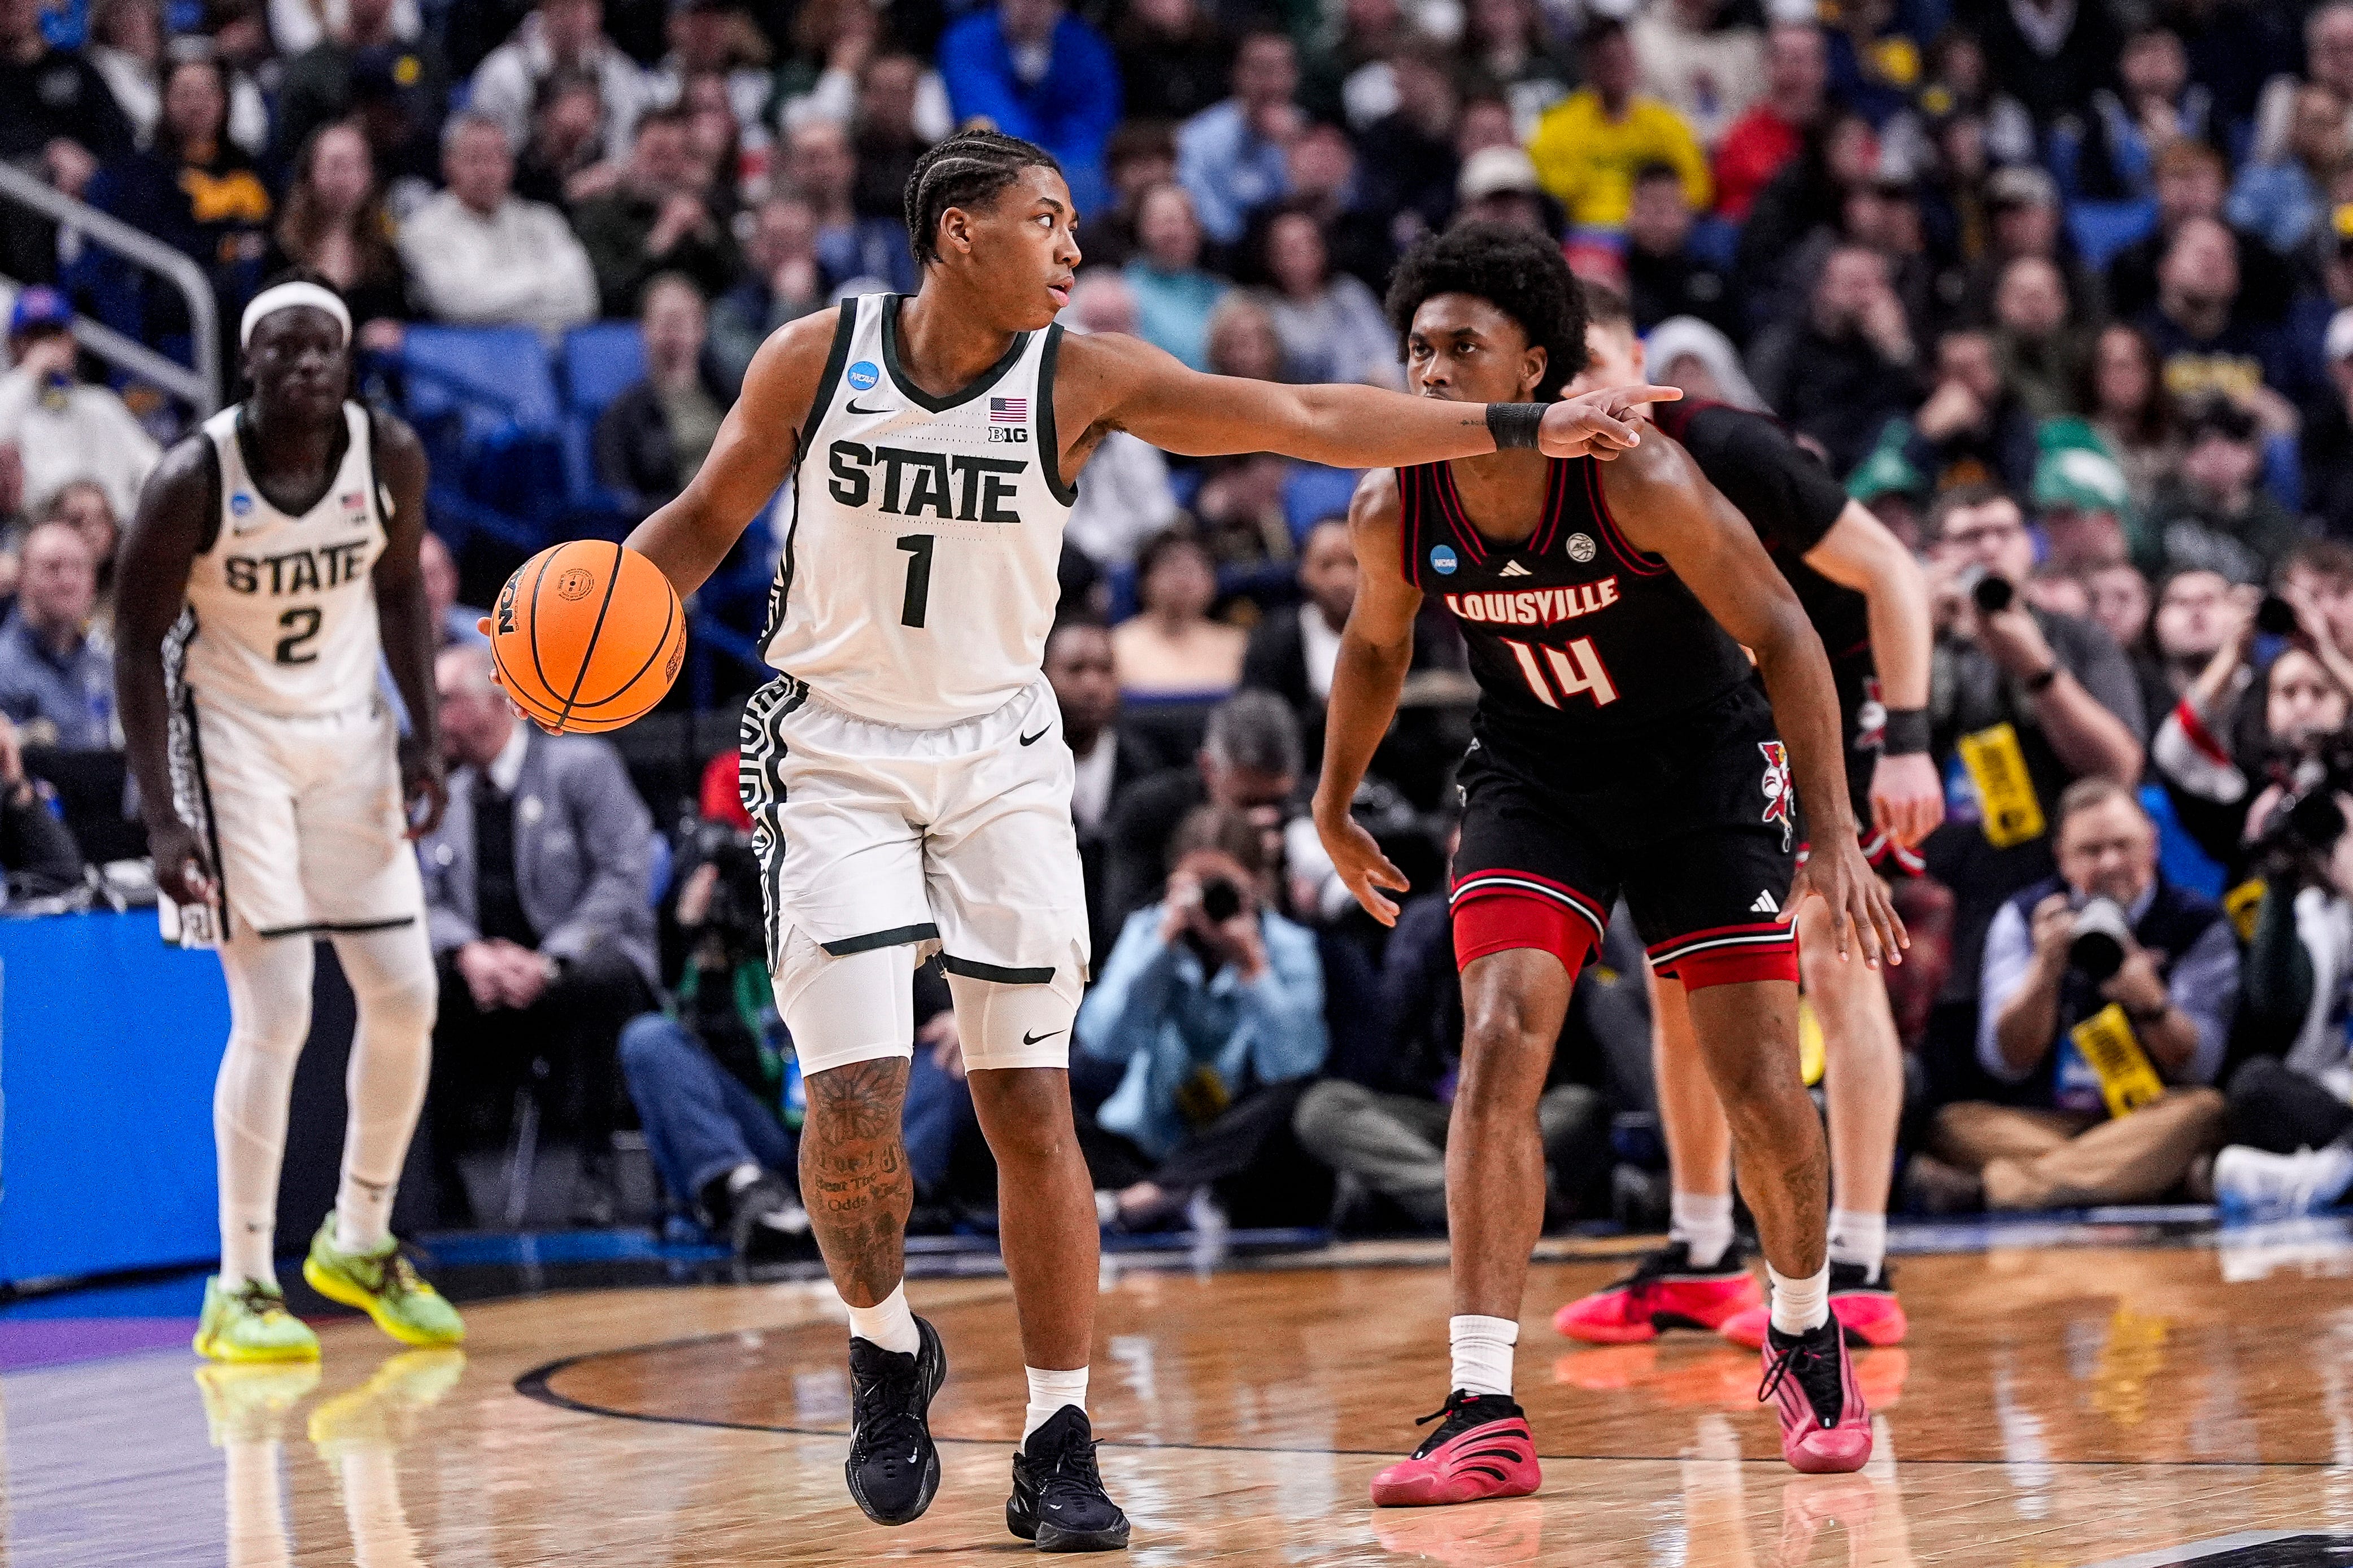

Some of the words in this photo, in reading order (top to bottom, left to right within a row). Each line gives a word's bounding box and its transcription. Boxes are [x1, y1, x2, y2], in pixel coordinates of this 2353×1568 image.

[851, 372, 877, 385] NCAA
[829, 440, 1029, 523] STATE
[225, 538, 370, 596] STATE
[896, 534, 934, 628] 1
[1434, 558, 1457, 567] NCAA
[1444, 575, 1620, 628] LOUISVILLE
[276, 605, 321, 666] 2
[1498, 635, 1620, 711] 14
[827, 1195, 868, 1212] Odds
